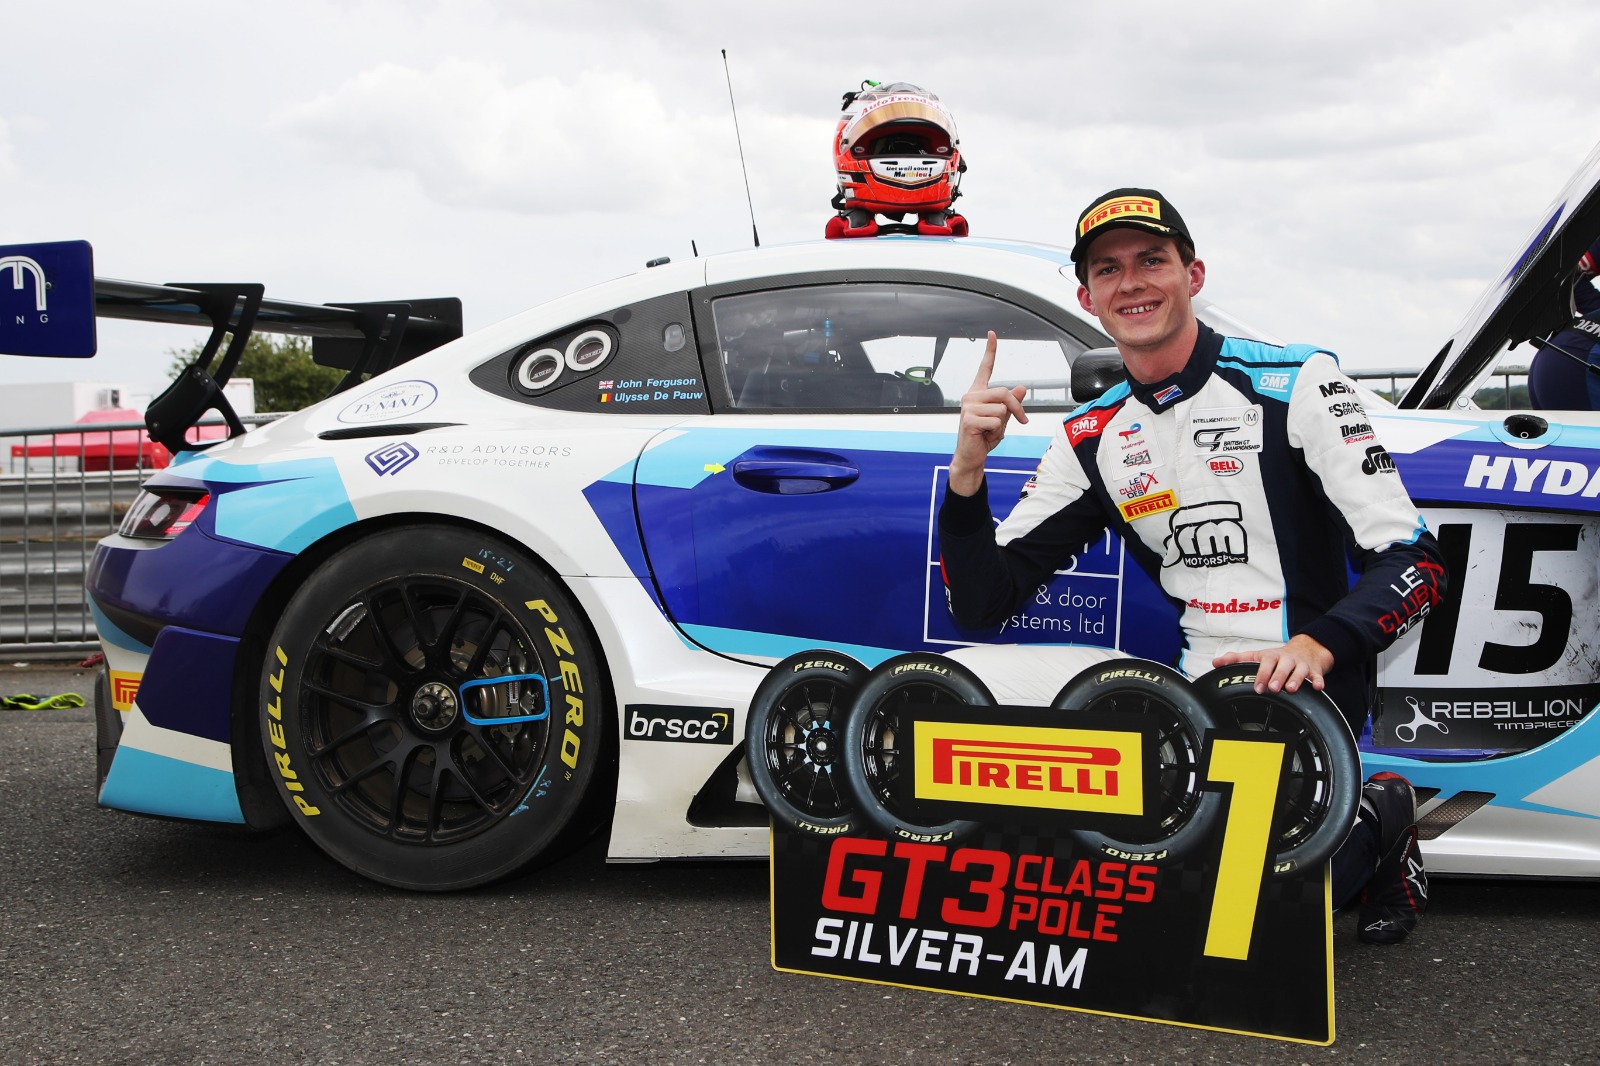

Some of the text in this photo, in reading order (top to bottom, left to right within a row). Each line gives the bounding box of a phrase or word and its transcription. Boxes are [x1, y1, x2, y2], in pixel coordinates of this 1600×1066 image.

[1083, 200, 1154, 234] PIRELLI
[616, 378, 697, 389] John Ferguson
[1260, 375, 1290, 389] OMP
[614, 390, 703, 403] Ulysse De Pauw
[1071, 419, 1098, 435] OMP
[1344, 433, 1376, 445] Racing
[427, 445, 572, 457] R&D ADVISORS
[494, 459, 550, 469] TOGETHER
[1210, 460, 1240, 471] BELL
[1129, 477, 1140, 486] LE
[1119, 483, 1142, 496] CLUB
[1127, 489, 1144, 499] DES
[1124, 493, 1173, 517] PIRELLI
[1185, 554, 1246, 567] MOTORSPORT
[1390, 567, 1424, 598] LE
[1035, 584, 1107, 609] & door
[1413, 522, 1584, 676] 15
[1377, 584, 1430, 634] CLUB
[1000, 612, 1105, 635] ystems ltd
[894, 663, 948, 675] PIRELLI
[1100, 669, 1161, 682] PIRELLI
[1218, 675, 1257, 688] PZE
[267, 645, 321, 817] PIRELLI
[630, 711, 719, 739] brscc
[932, 737, 1122, 797] PIRELLI
[798, 821, 849, 834] PIRELLI
[1203, 738, 1286, 961] 1
[821, 837, 1158, 928] GT3 CLASS
[1008, 897, 1123, 942] POLE
[810, 917, 1089, 990] SILVER-AM
